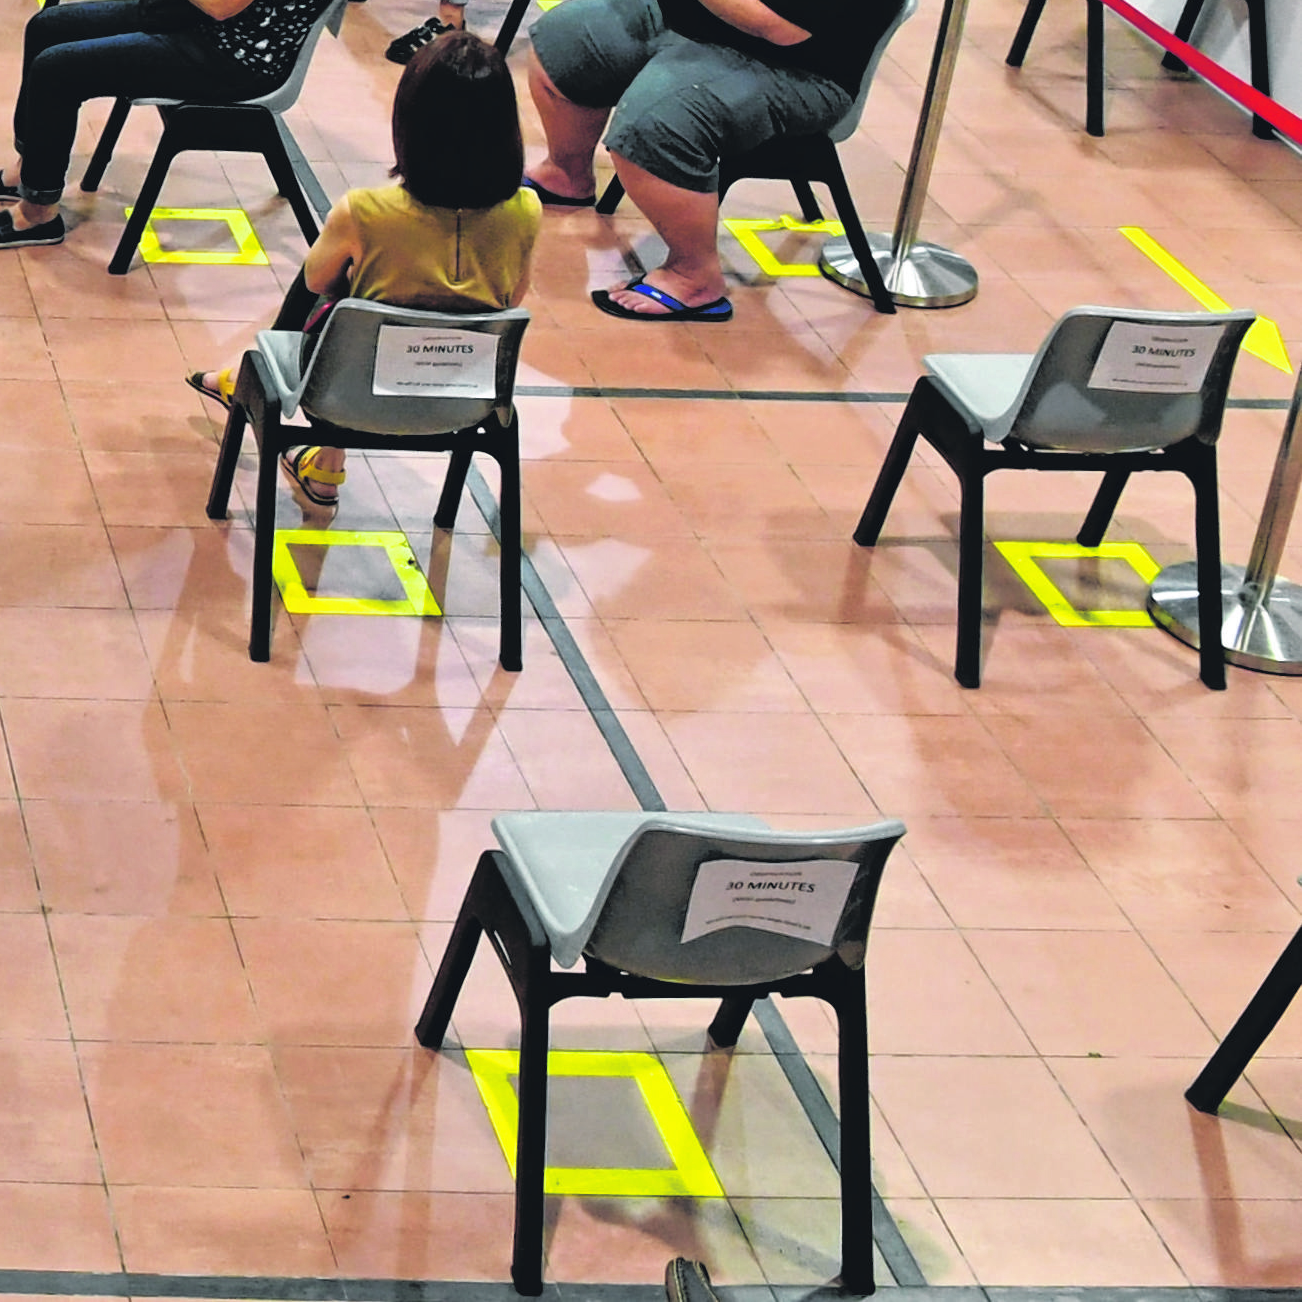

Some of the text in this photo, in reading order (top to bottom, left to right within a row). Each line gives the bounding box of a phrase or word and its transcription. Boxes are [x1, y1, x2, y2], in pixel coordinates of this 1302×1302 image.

[406, 345, 474, 354] 30 MINUTES
[1131, 345, 1196, 357] 30 MINUTES
[726, 881, 816, 893] 30 MINUTES
